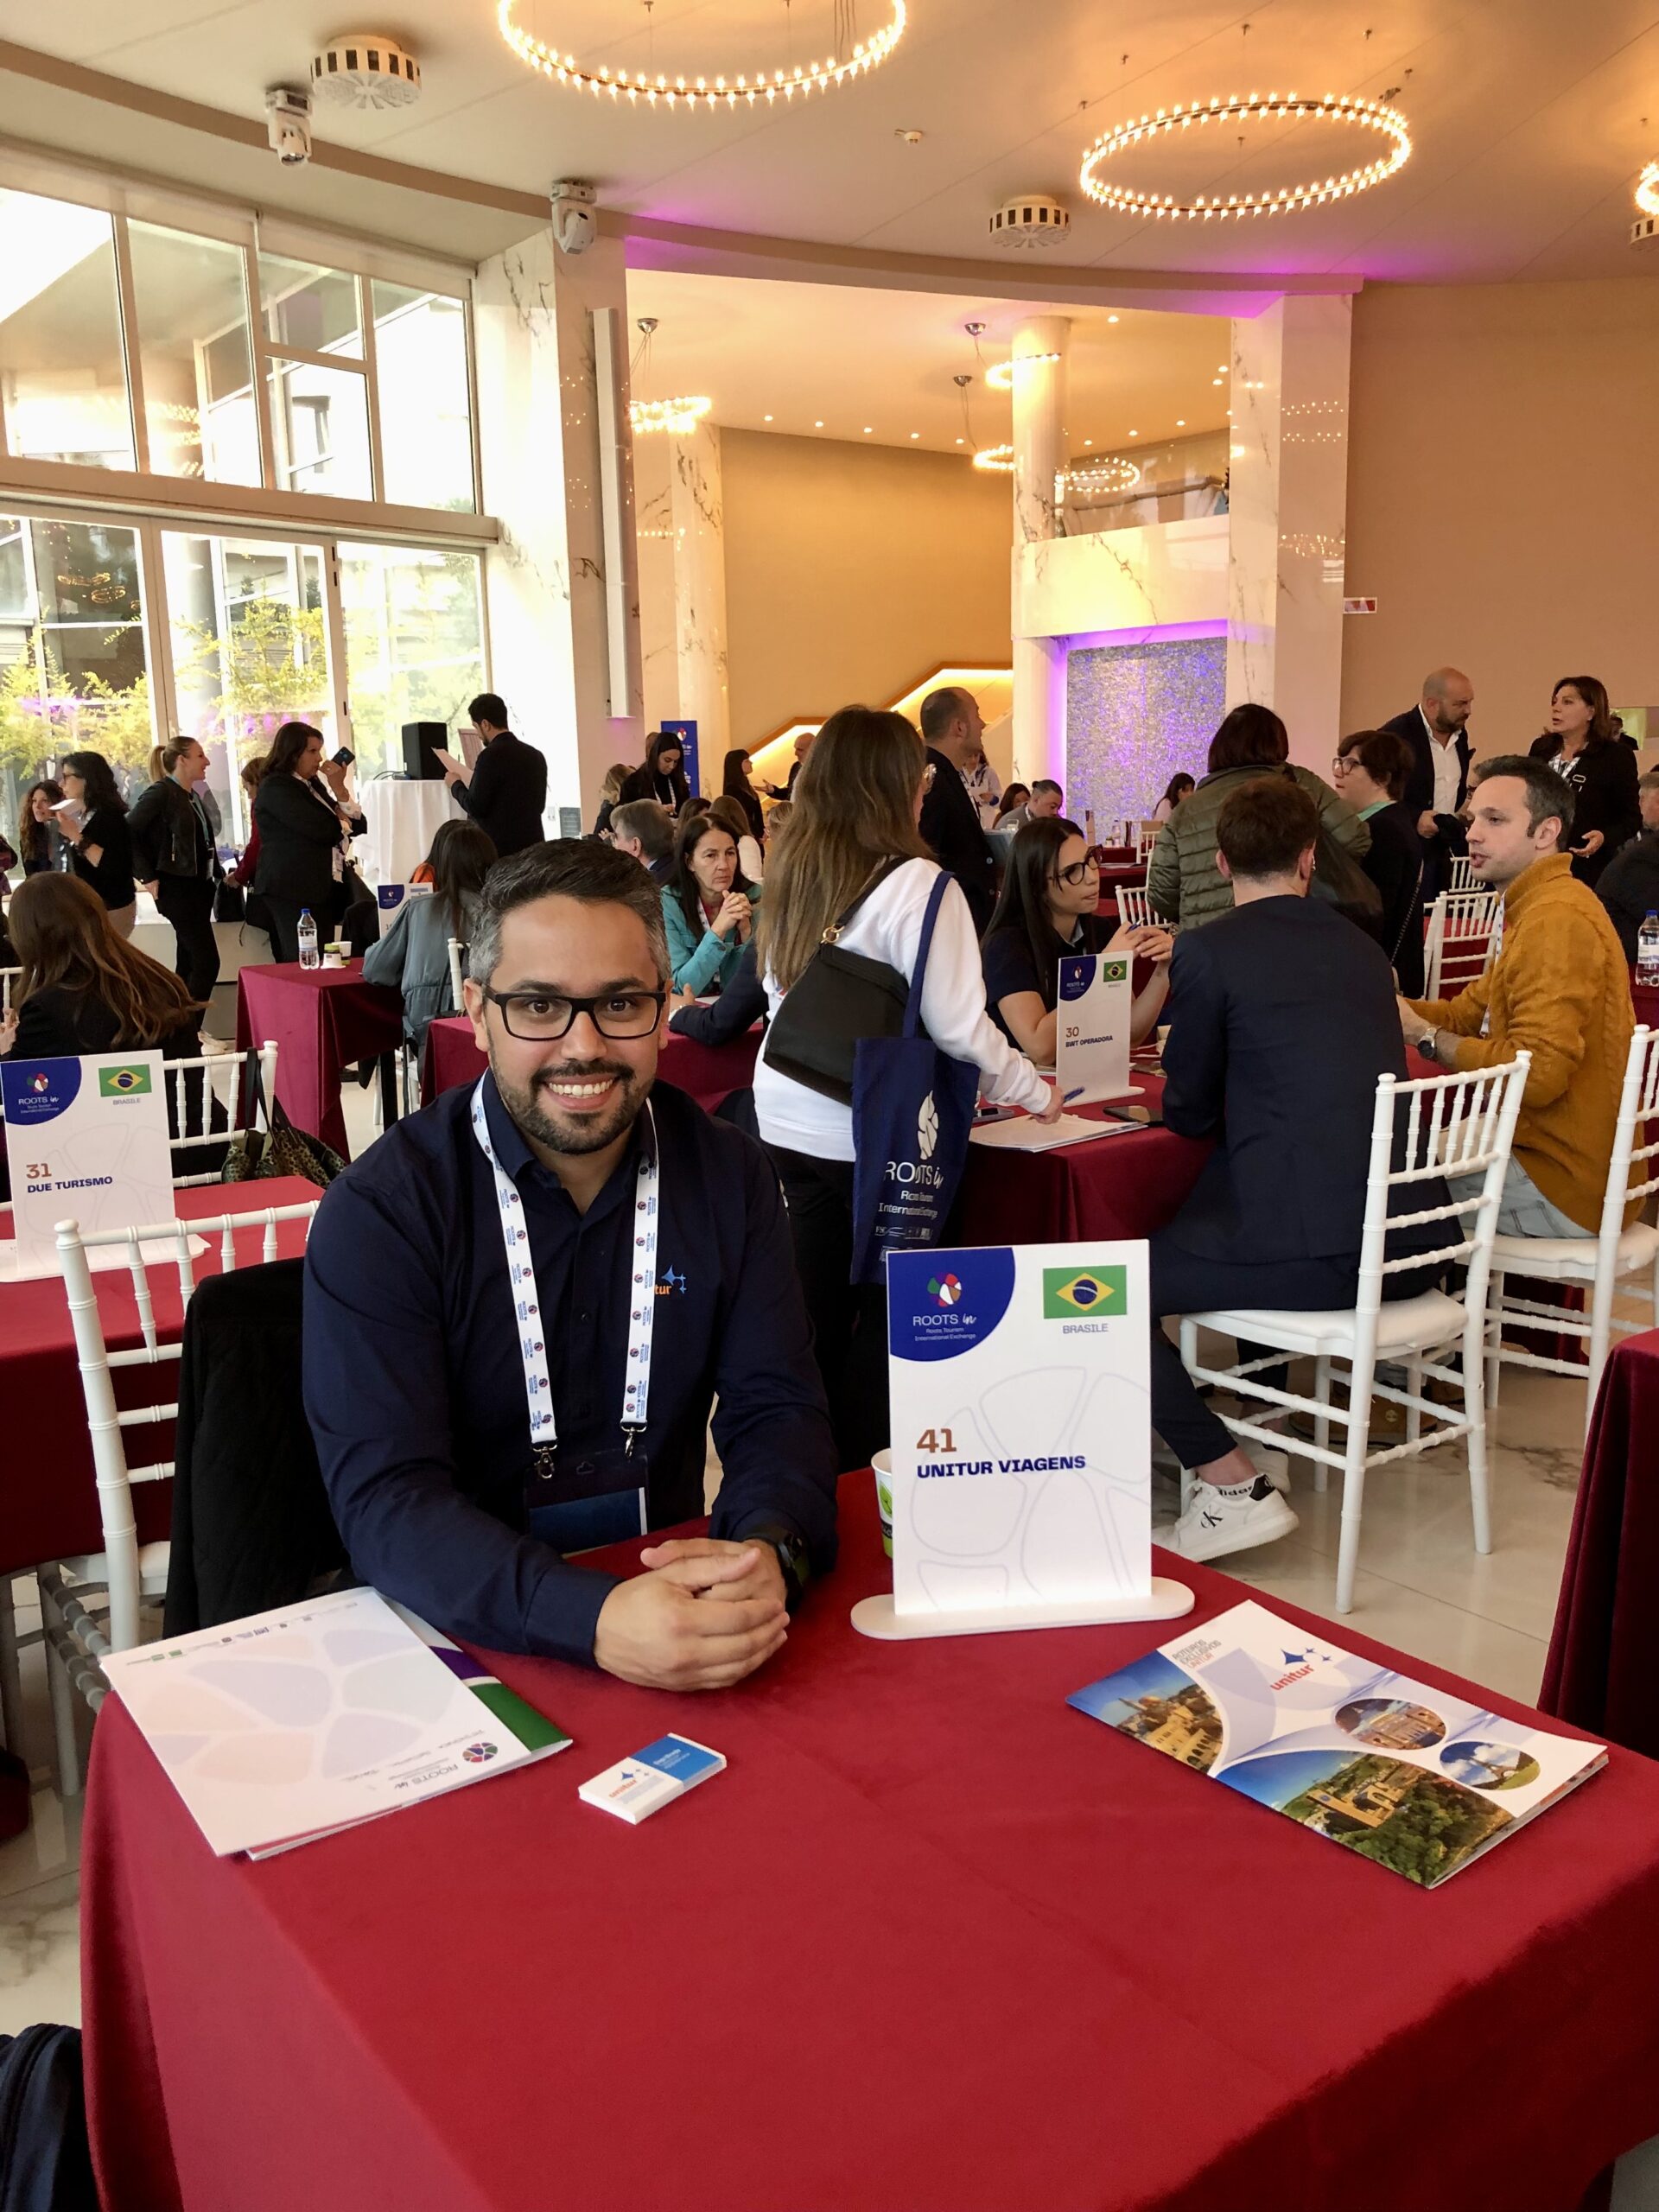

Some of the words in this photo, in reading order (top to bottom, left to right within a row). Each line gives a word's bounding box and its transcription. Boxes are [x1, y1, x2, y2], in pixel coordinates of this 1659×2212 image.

[1065, 1027, 1079, 1038] 30
[1079, 1035, 1113, 1046] OPERADORA
[18, 1096, 48, 1105] ROOTS
[112, 1097, 141, 1106] BRASILE
[26, 1163, 52, 1179] 31
[27, 1183, 52, 1193] DUE
[54, 1176, 113, 1190] TURISMO
[654, 1284, 672, 1295] tur
[912, 1314, 959, 1326] ROOTS
[962, 1313, 977, 1325] in
[1063, 1323, 1109, 1334] BRASILE
[916, 1428, 957, 1453] 41
[917, 1460, 993, 1478] UNITUR
[998, 1455, 1086, 1473] VIAGENS
[1269, 1664, 1314, 1691] unitur
[412, 1764, 459, 1784] ROOTS
